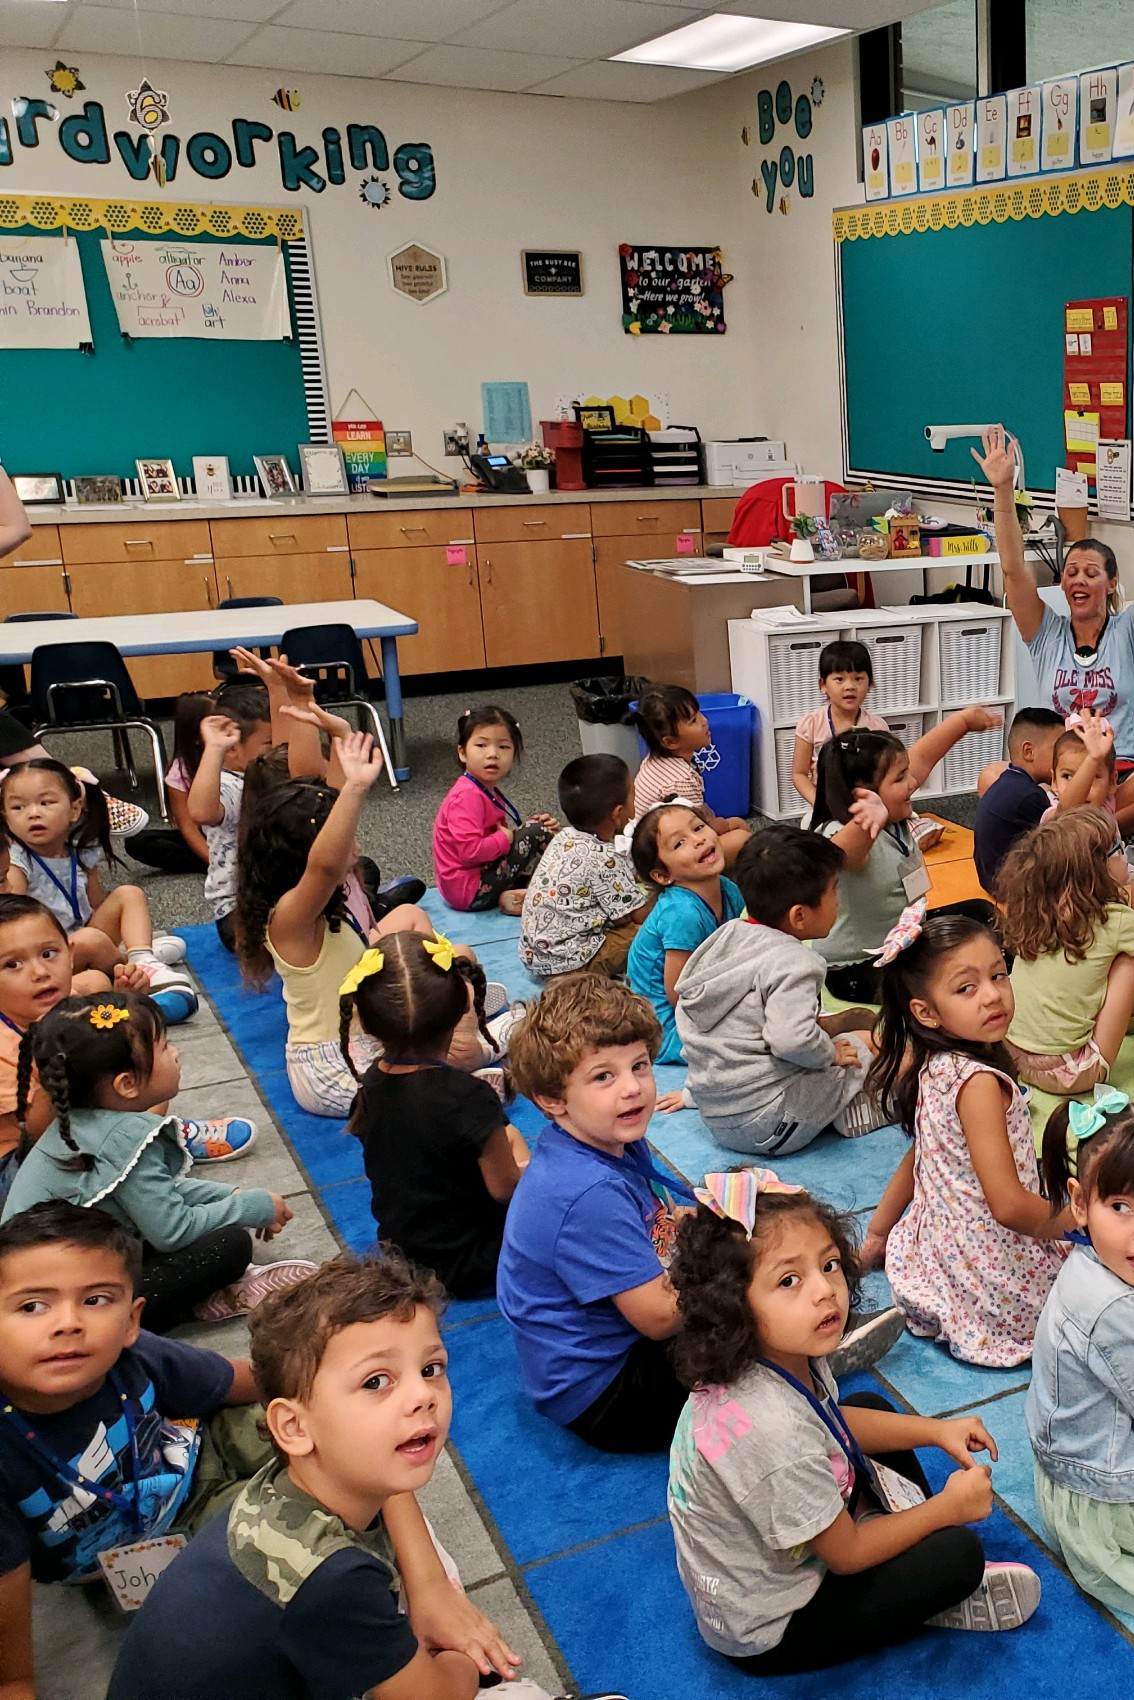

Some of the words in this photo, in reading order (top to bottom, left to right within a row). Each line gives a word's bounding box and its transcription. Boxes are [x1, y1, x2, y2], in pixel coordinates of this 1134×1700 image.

[1089, 75, 1107, 99] Hh
[1018, 91, 1033, 113] Ff
[1050, 85, 1069, 116] Gg
[953, 107, 968, 129] Dd
[986, 101, 998, 121] Ee
[895, 121, 908, 141] Bb
[923, 115, 937, 134] Cc
[869, 129, 882, 147] Aa
[112, 254, 143, 268] apple
[159, 251, 207, 265] alligator
[219, 252, 257, 266] Amber
[530, 259, 543, 267] THE
[545, 258, 563, 266] BUSY
[625, 250, 715, 272] WELCOME
[175, 269, 197, 291] Aa
[221, 270, 251, 286] Anna
[534, 274, 573, 284] COMPANY
[652, 278, 671, 287] our
[2, 280, 38, 297] boat
[116, 289, 157, 302] anchor
[222, 289, 257, 304] Alexa
[643, 290, 664, 301] Here
[666, 293, 679, 302] we
[26, 300, 80, 317] Brandon
[138, 313, 182, 327] acrobat
[204, 316, 226, 330] art
[346, 432, 371, 440] LEARN
[345, 452, 375, 463] EVERY
[351, 463, 370, 474] DAY
[947, 541, 962, 554] Mrs.
[1053, 668, 1077, 691] OLE
[1083, 666, 1115, 691] MISS
[115, 1566, 164, 1590] Joh
